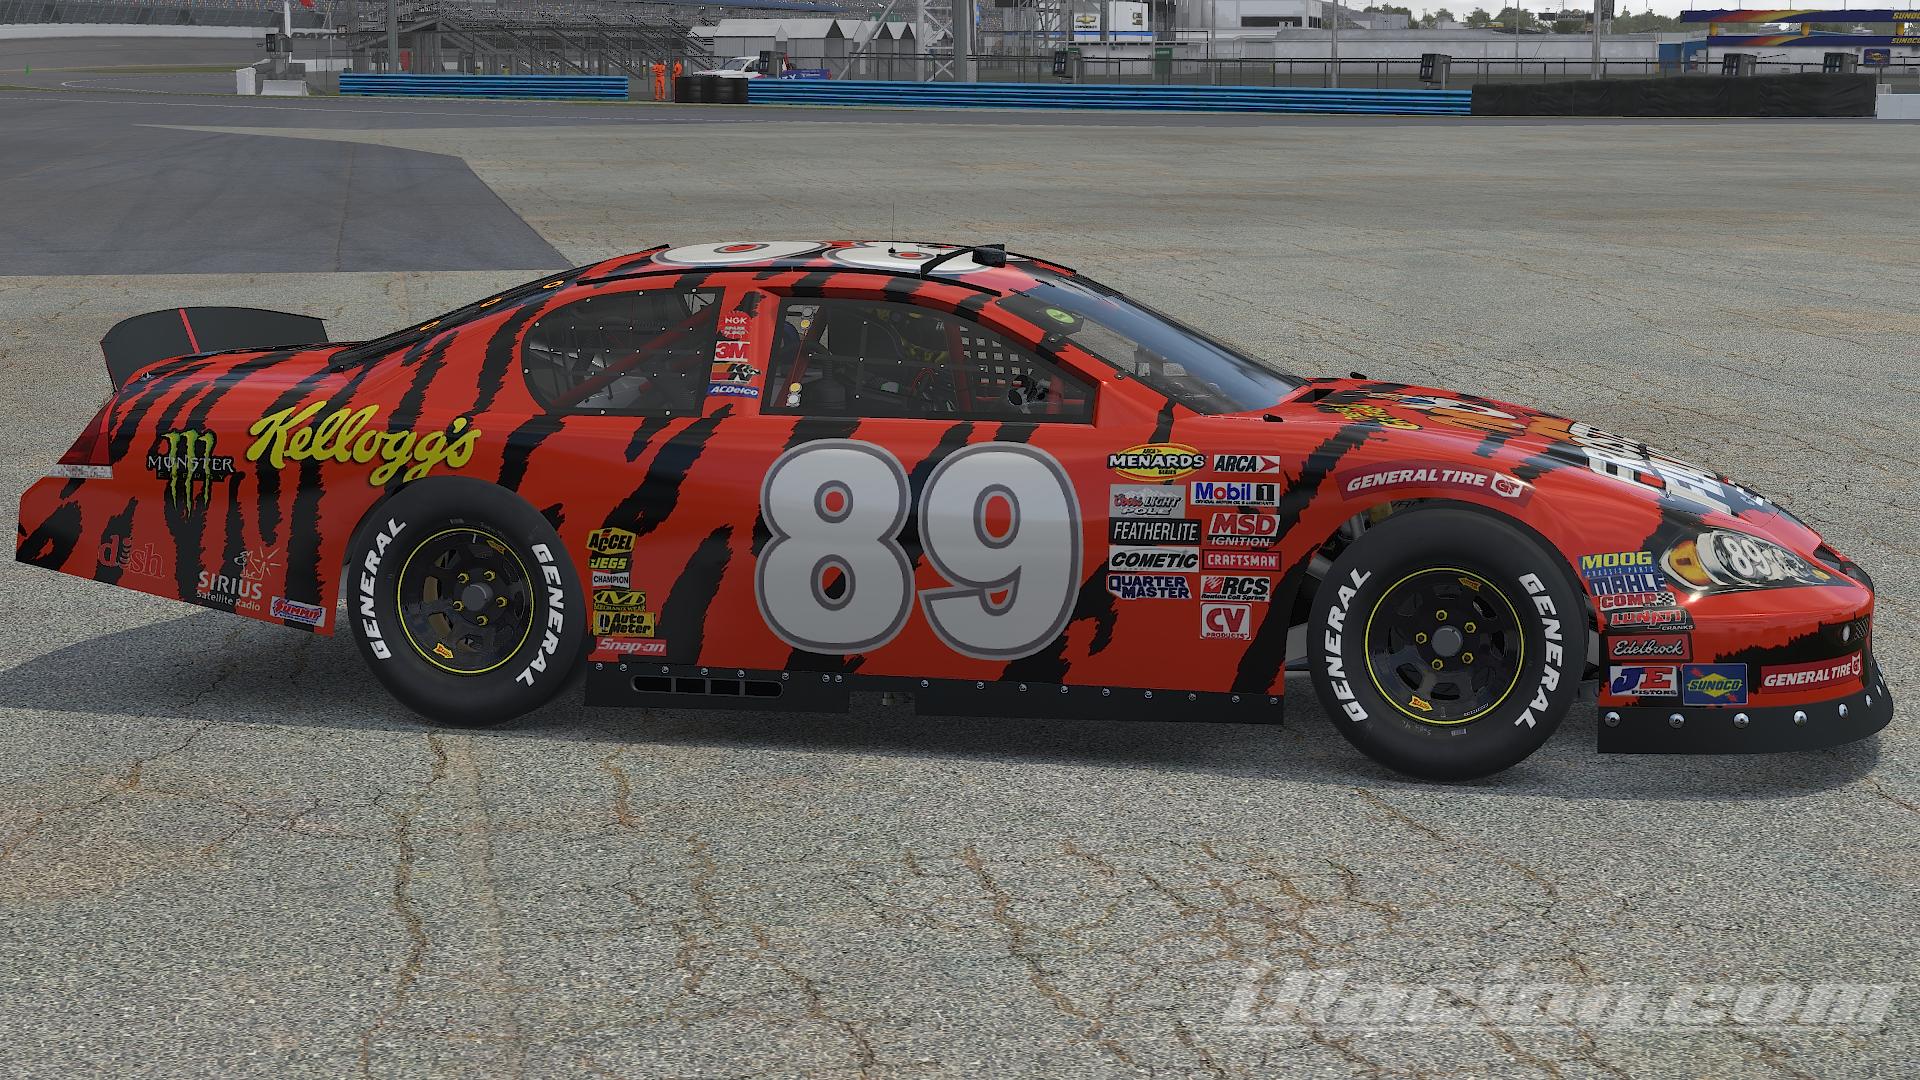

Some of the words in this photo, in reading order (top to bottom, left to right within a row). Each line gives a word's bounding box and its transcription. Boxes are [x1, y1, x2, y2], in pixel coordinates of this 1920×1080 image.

[724, 316, 748, 324] NGK
[716, 341, 748, 359] 3M
[710, 386, 758, 396] ACDelco
[245, 400, 482, 486] Kellogg's
[148, 454, 234, 472] MONSTER
[1108, 454, 1206, 468] MENARDS
[1214, 456, 1258, 472] ARCA
[1347, 468, 1438, 492] GENERAL
[1441, 469, 1488, 487] TIRE
[1195, 482, 1251, 500] Mobil
[1144, 496, 1181, 508] LIGHT
[1121, 507, 1172, 516] POLE
[1114, 521, 1198, 541] FEATHERLITE
[1211, 513, 1276, 535] MSD
[753, 438, 1084, 661] 89
[1211, 536, 1270, 546] IGNITION
[98, 534, 166, 579] dish
[590, 557, 628, 570] JEGS
[1111, 552, 1198, 568] COMETIC
[1207, 554, 1277, 567] CRAFTSMAN
[1582, 551, 1653, 570] MOOG
[198, 570, 263, 600] SIRIUS
[593, 575, 629, 584] CHAMPION
[1109, 575, 1186, 591] QUARTER
[1222, 577, 1269, 595] RCS
[1591, 573, 1667, 596] MAHLE
[359, 518, 407, 660] GENERAL
[1122, 587, 1190, 598] MASTER
[1241, 594, 1266, 602] Spring
[196, 589, 233, 606] Satellite
[235, 598, 261, 612] Radio
[1600, 592, 1658, 609] COMP
[515, 543, 565, 686] GENERAL
[612, 613, 645, 624] Auto
[1206, 607, 1246, 633] CV
[611, 624, 651, 634] Meter
[598, 639, 666, 654] Snap-on
[1325, 568, 1371, 722] GENERAL
[1514, 572, 1563, 728] GENERAL
[1613, 639, 1684, 656] Edelbrock
[1612, 667, 1674, 694] JE
[1763, 668, 1830, 687] GENERAL
[1831, 662, 1852, 679] TIRE
[1688, 680, 1741, 690] SUNOCO
